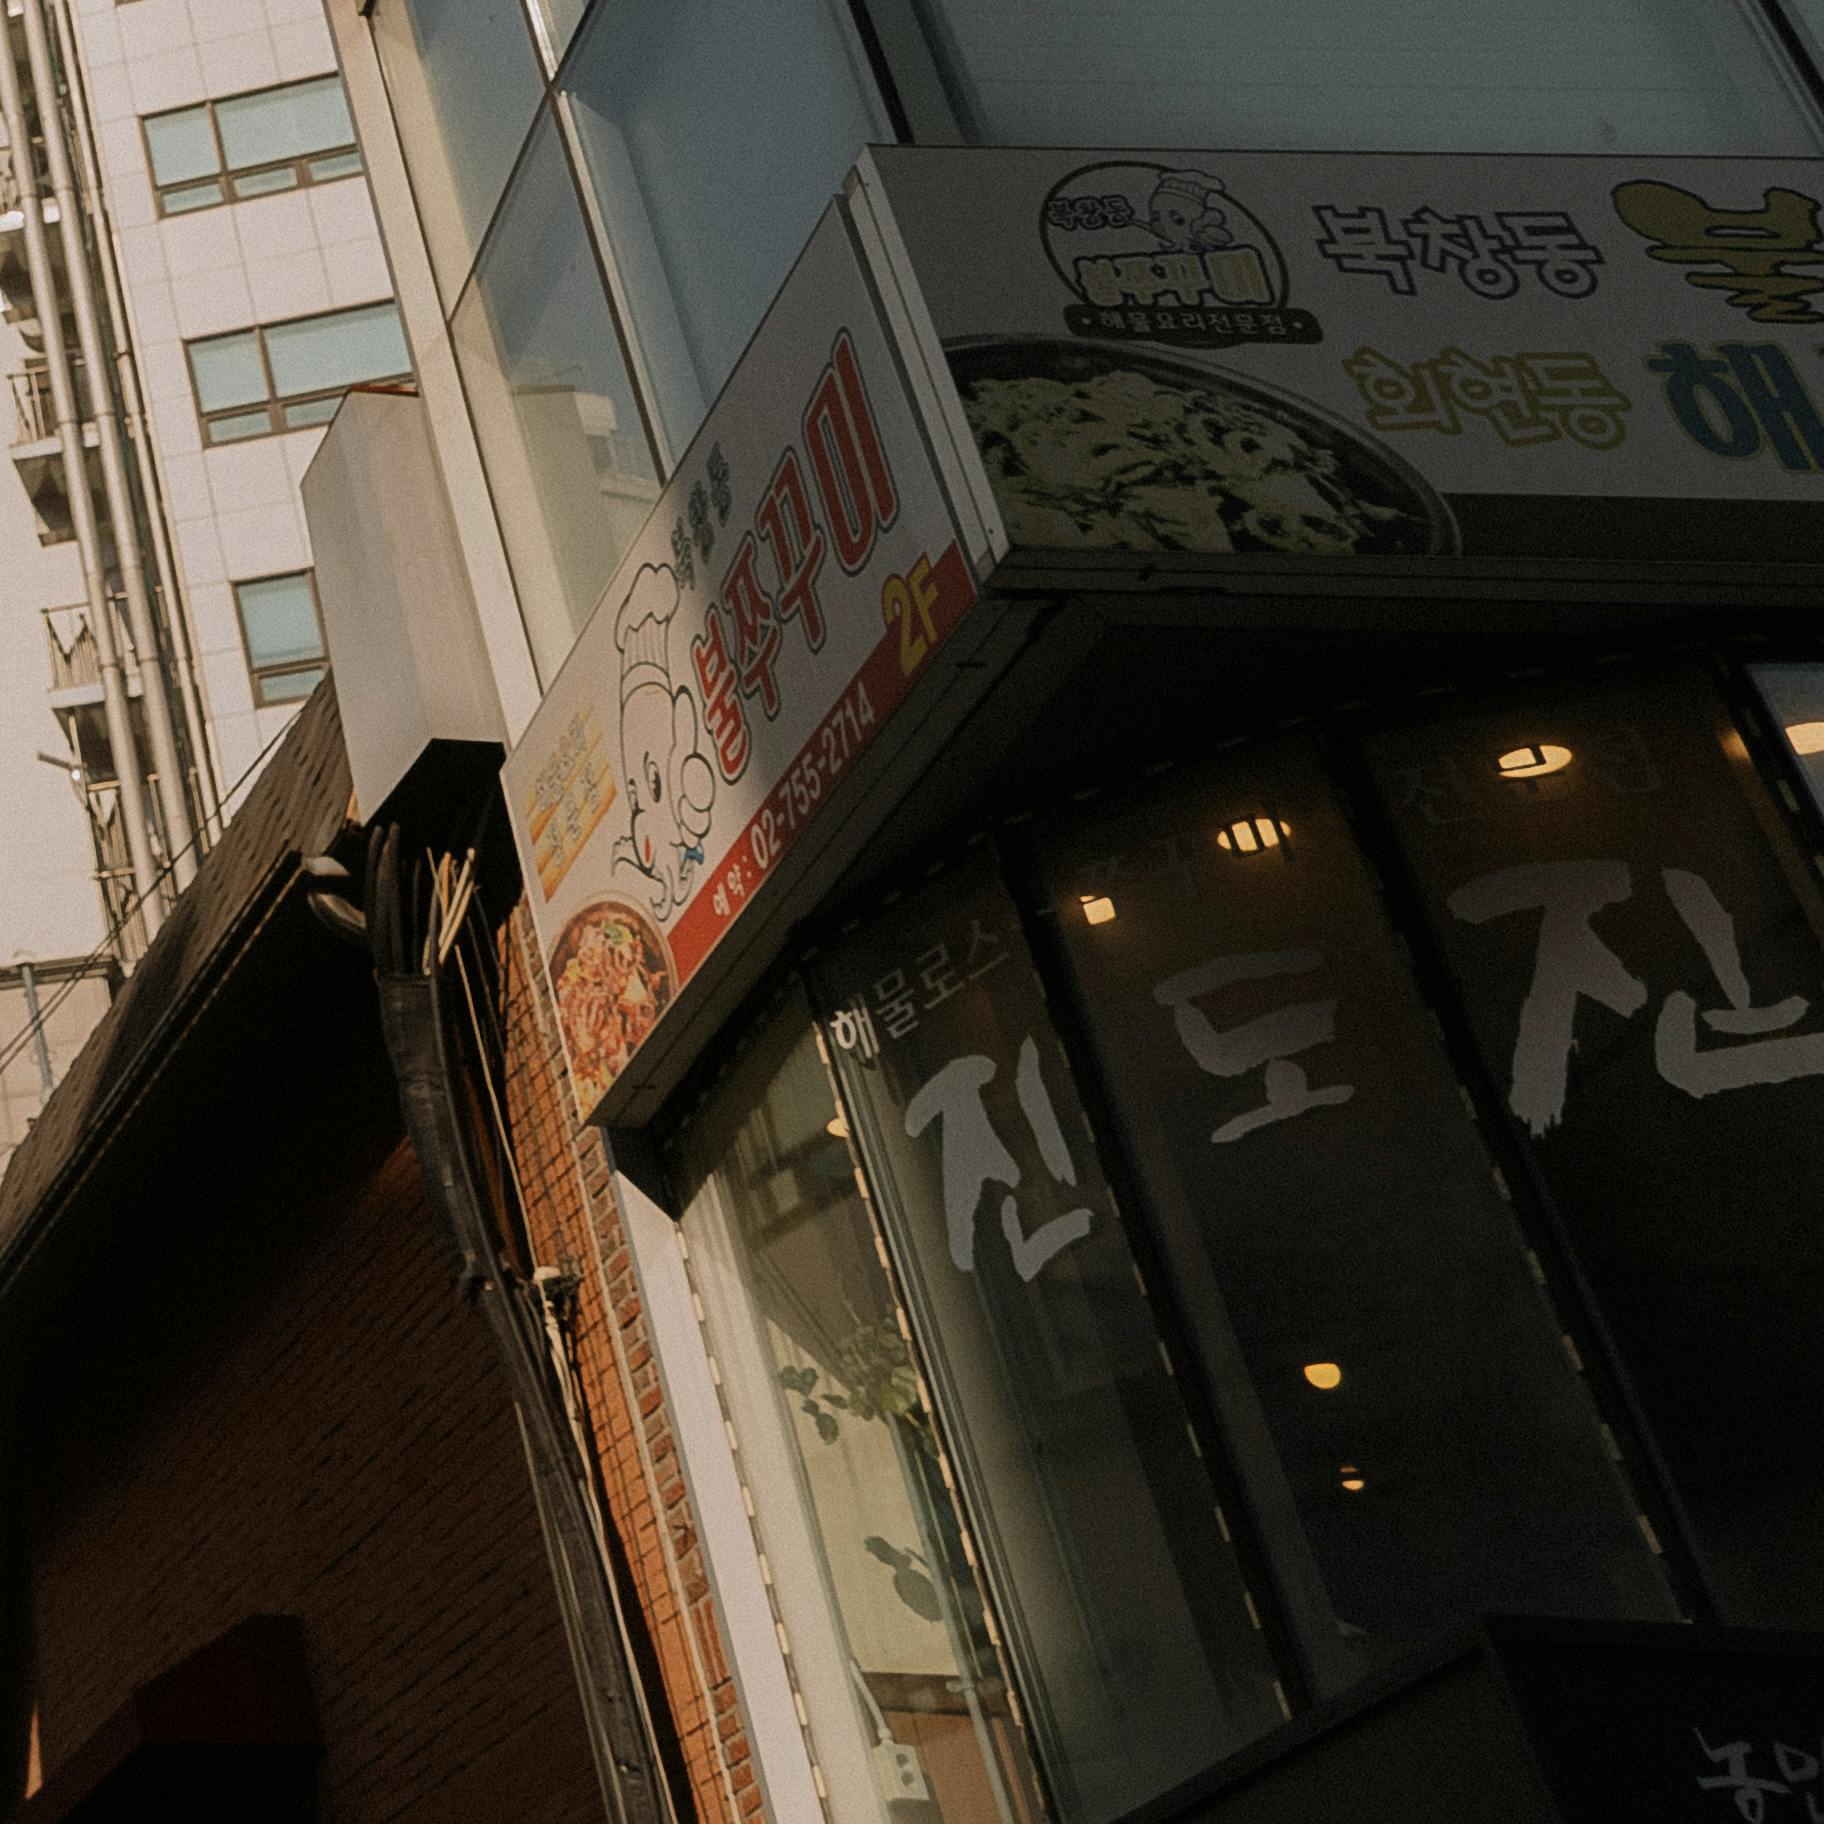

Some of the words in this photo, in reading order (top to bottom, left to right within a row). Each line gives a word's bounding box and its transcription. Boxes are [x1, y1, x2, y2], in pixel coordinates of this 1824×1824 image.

[1313, 204, 1606, 300] 북창동
[1098, 310, 1288, 336] 해물요리전문점
[1343, 345, 1632, 451] 회현동
[690, 326, 901, 785] 불쭈꾸미
[881, 550, 940, 678] 2F
[752, 699, 876, 874] 02-755-2714
[830, 918, 1011, 1059] 해물로스
